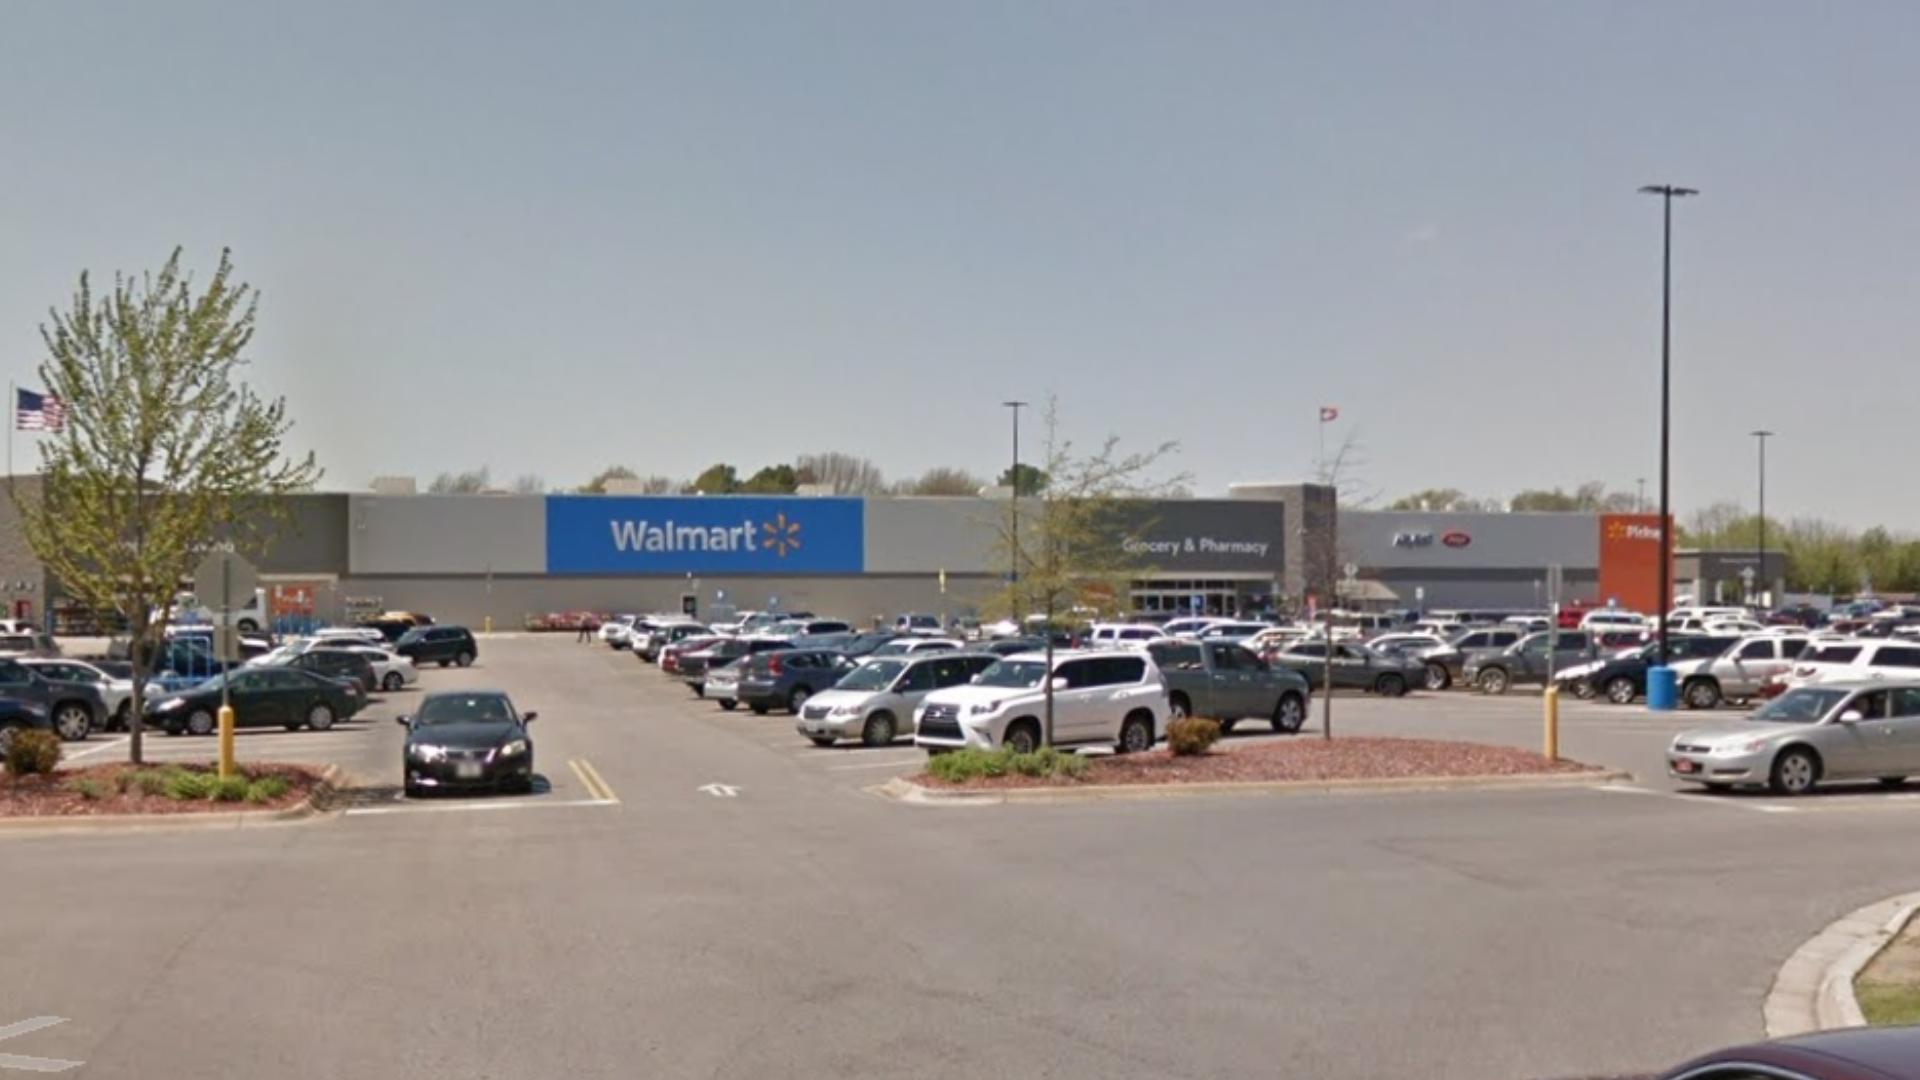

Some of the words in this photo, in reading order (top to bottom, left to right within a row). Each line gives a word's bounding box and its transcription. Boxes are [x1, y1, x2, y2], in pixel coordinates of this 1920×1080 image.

[610, 520, 757, 551] Walmart
[1122, 537, 1179, 556] Grocery
[1184, 537, 1195, 552] &
[1199, 537, 1268, 557] Pharmacy
